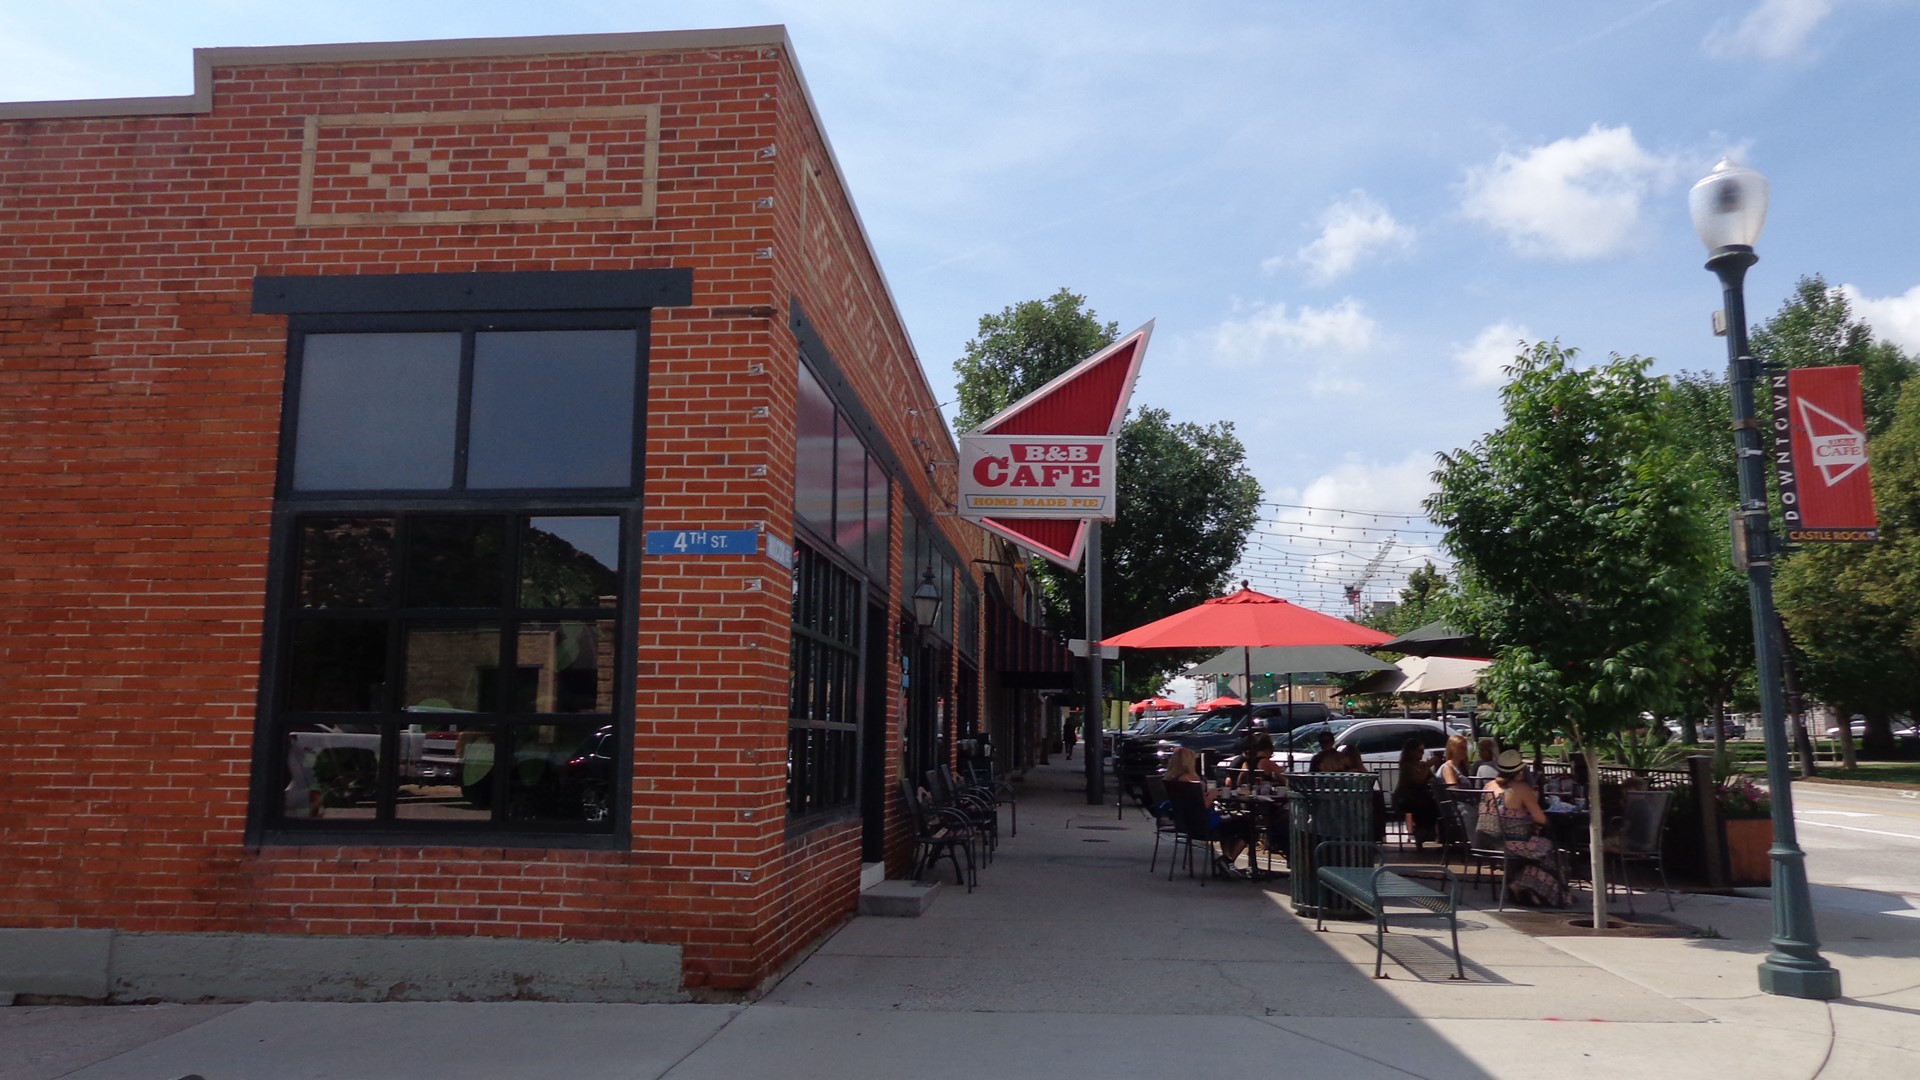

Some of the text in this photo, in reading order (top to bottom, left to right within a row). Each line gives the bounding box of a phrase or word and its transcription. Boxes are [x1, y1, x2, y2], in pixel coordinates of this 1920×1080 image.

[1025, 446, 1089, 462] B&B
[1773, 375, 1800, 521] DOWNTOWN
[973, 456, 1100, 487] CAFE
[973, 497, 1099, 507] HOME MADE PIE
[674, 532, 728, 552] 4TH ST.
[1789, 531, 1867, 541] CASTLE ROCK
